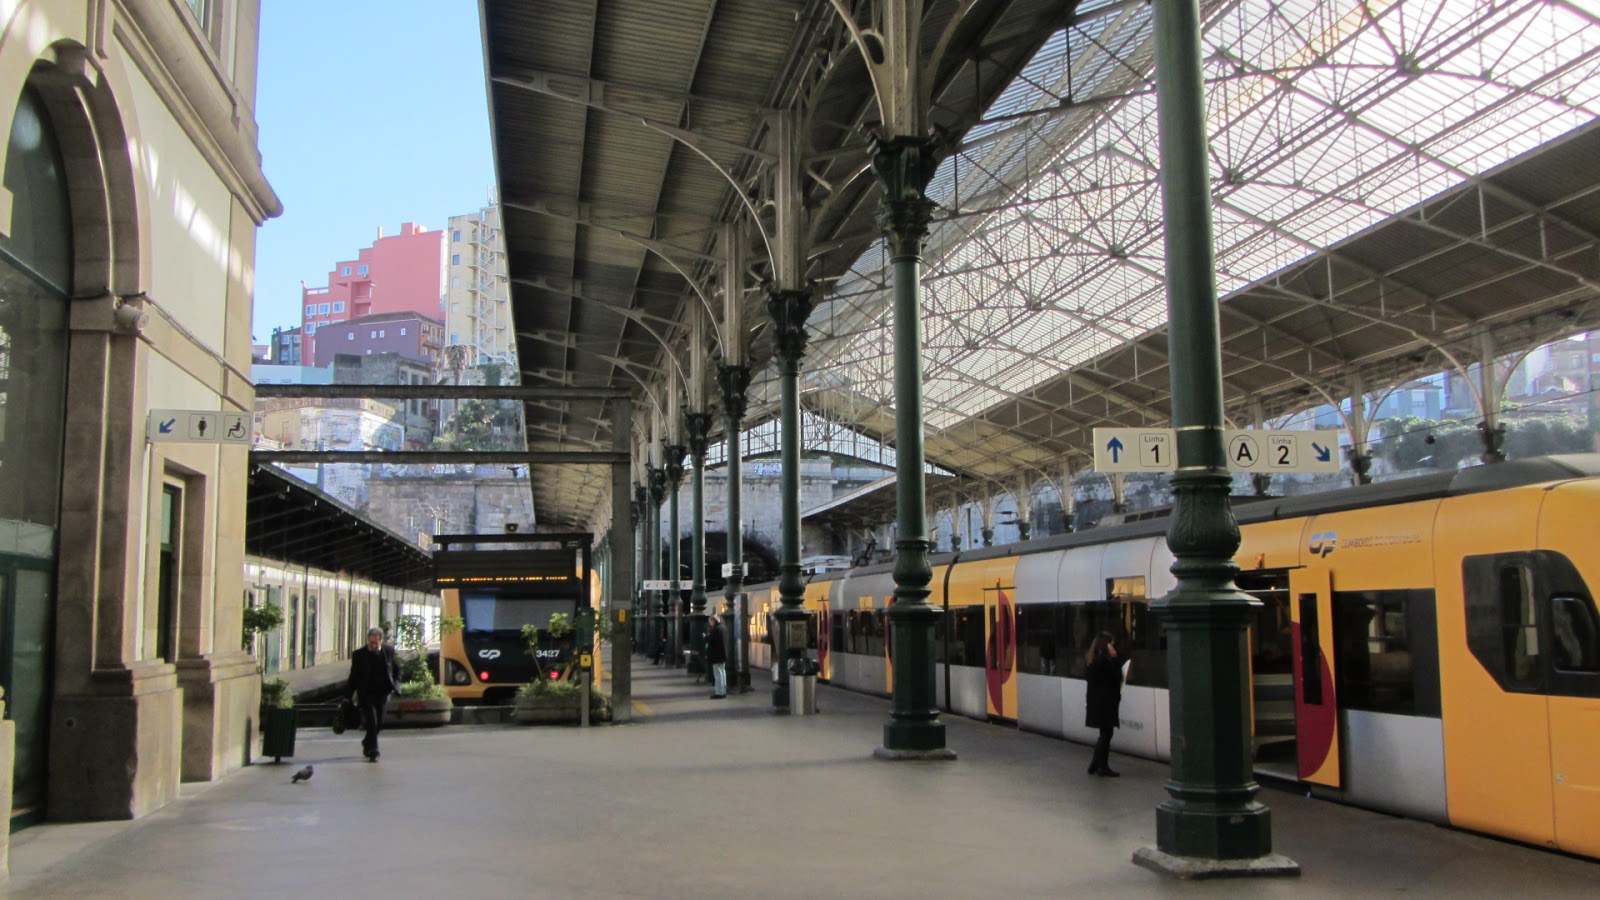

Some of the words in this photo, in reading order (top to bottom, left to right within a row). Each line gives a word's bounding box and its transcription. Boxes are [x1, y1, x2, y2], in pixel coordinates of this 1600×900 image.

[1151, 444, 1160, 463] 1
[1236, 442, 1253, 462] A
[1277, 445, 1290, 465] 2
[536, 650, 560, 658] 3427
